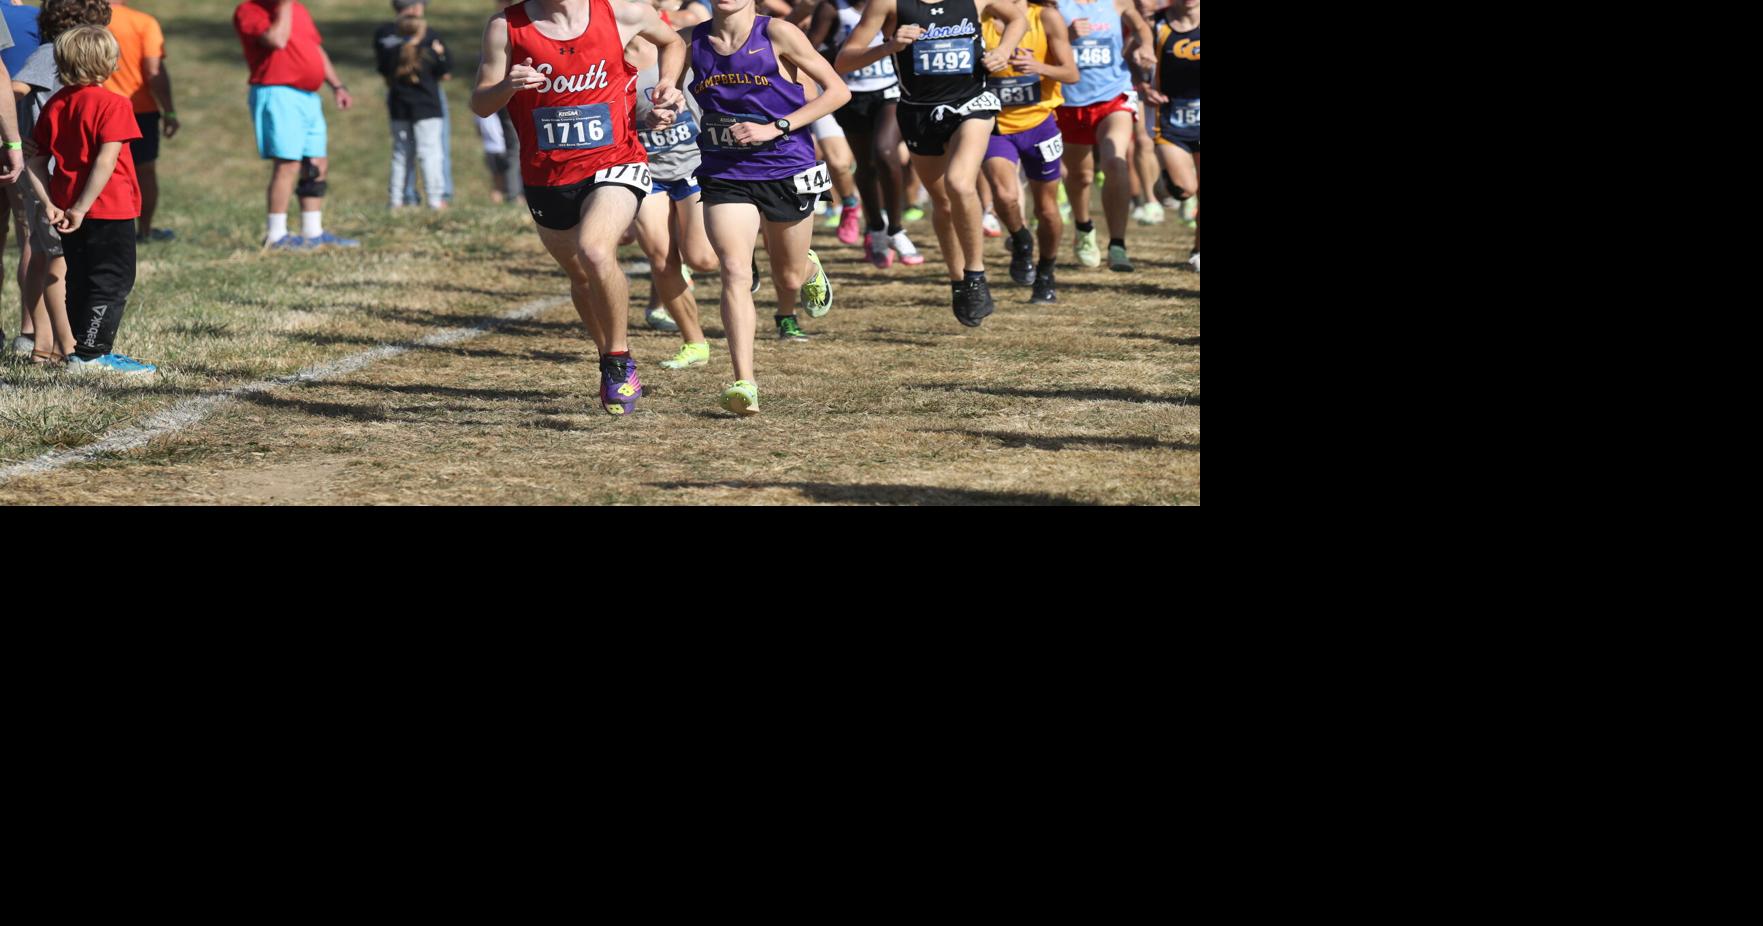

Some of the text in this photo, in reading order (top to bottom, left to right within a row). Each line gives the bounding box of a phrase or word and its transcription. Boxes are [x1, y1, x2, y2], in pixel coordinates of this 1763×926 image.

[854, 55, 895, 77] 616
[919, 51, 972, 70] 1492
[1073, 48, 1111, 64] 1468
[536, 59, 608, 94] South
[543, 119, 604, 144] 1716
[639, 124, 692, 148] 1688
[604, 163, 651, 187] 1716
